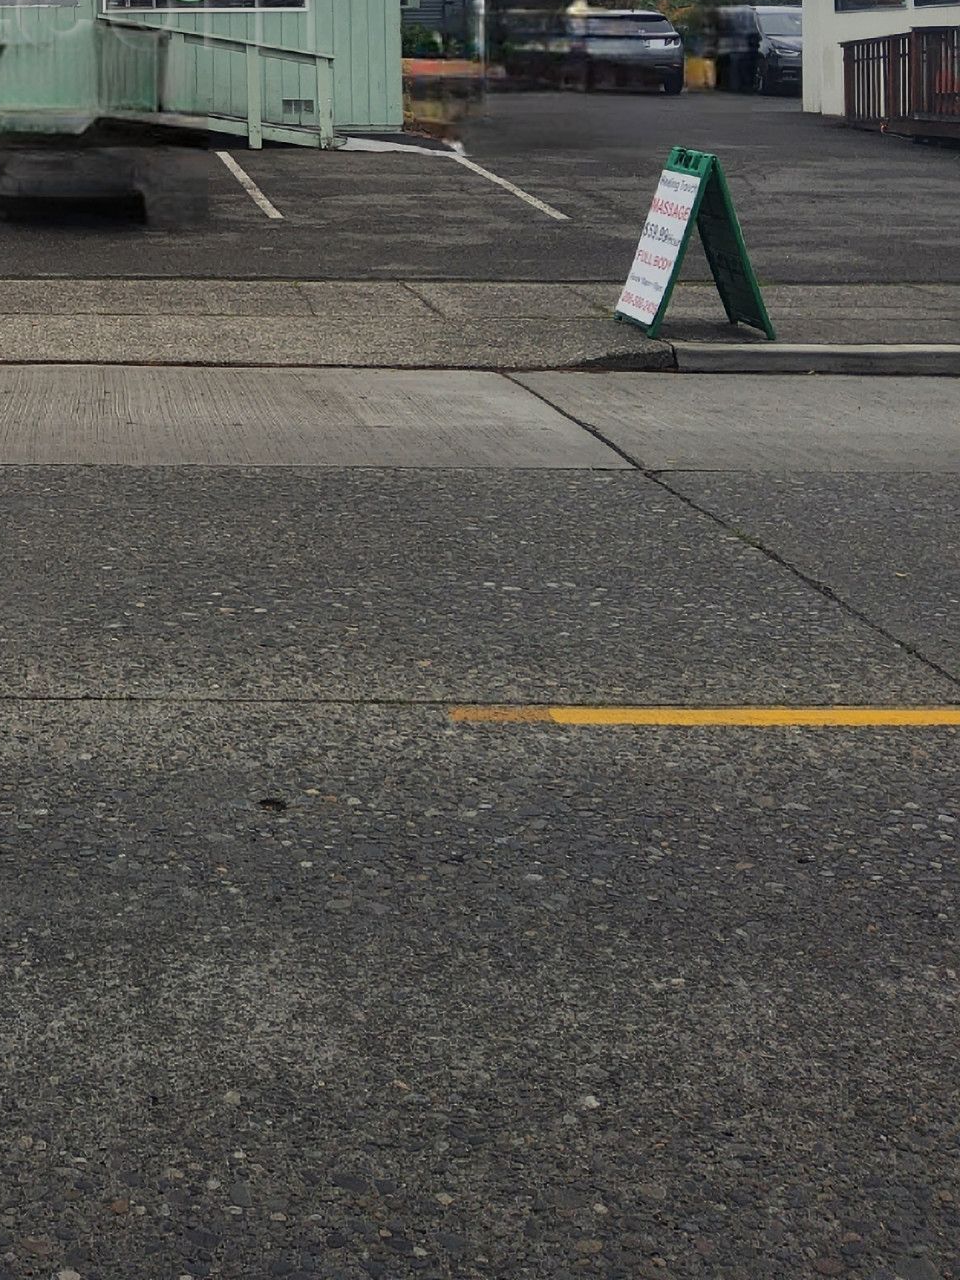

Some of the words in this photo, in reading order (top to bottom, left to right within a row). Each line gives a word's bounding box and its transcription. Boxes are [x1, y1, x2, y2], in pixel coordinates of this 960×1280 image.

[651, 197, 691, 221] MASSAGE
[638, 250, 653, 266] FULL
[653, 255, 673, 271] BODY
